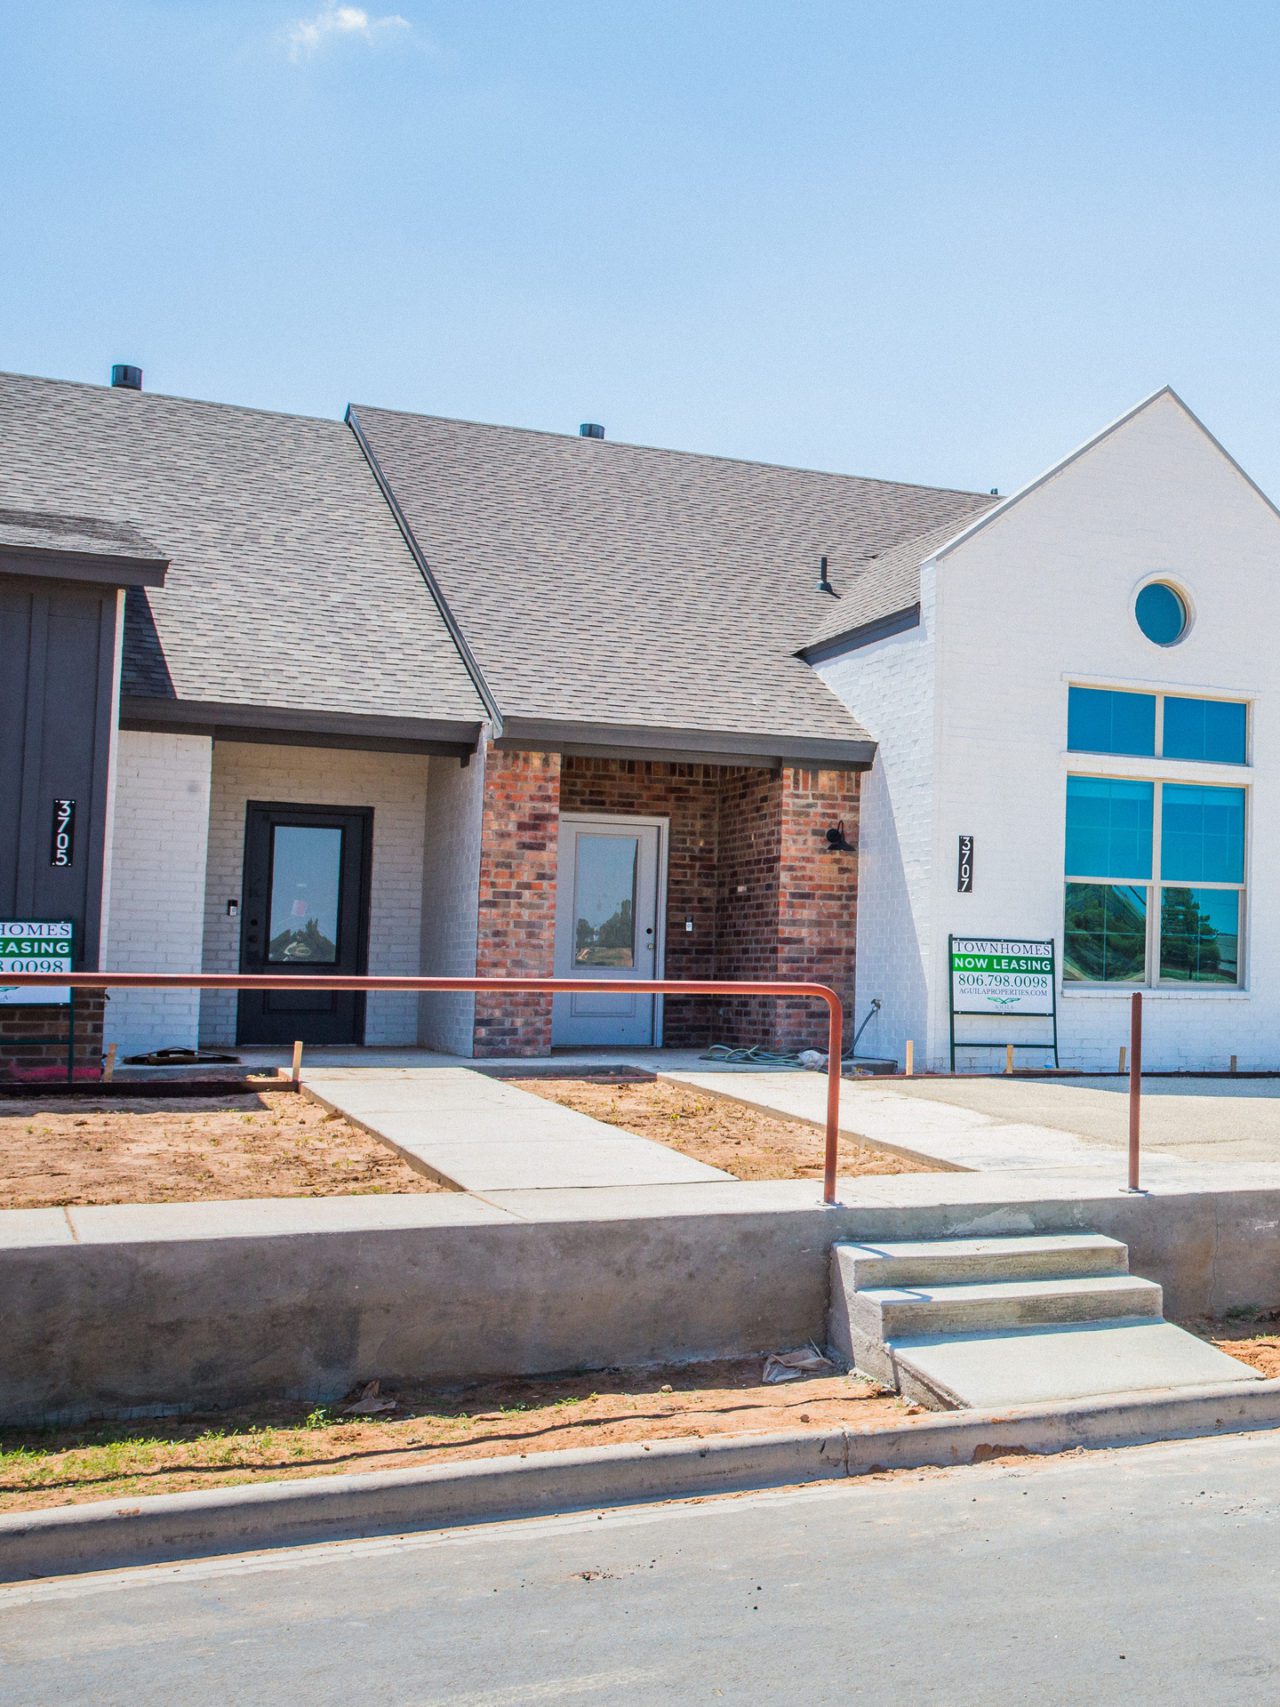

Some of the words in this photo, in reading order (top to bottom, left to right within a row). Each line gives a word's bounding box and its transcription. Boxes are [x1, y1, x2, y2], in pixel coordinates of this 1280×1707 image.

[56, 800, 71, 866] 3705
[961, 836, 971, 892] 3707
[954, 941, 1051, 955] TOWNHOMES
[0, 960, 63, 973] 0098
[954, 957, 988, 968] NOW
[993, 959, 1051, 971] LEASING
[958, 974, 1048, 988] 806.798.0098
[959, 987, 1048, 996] AGUILAPROPERTIES.COM
